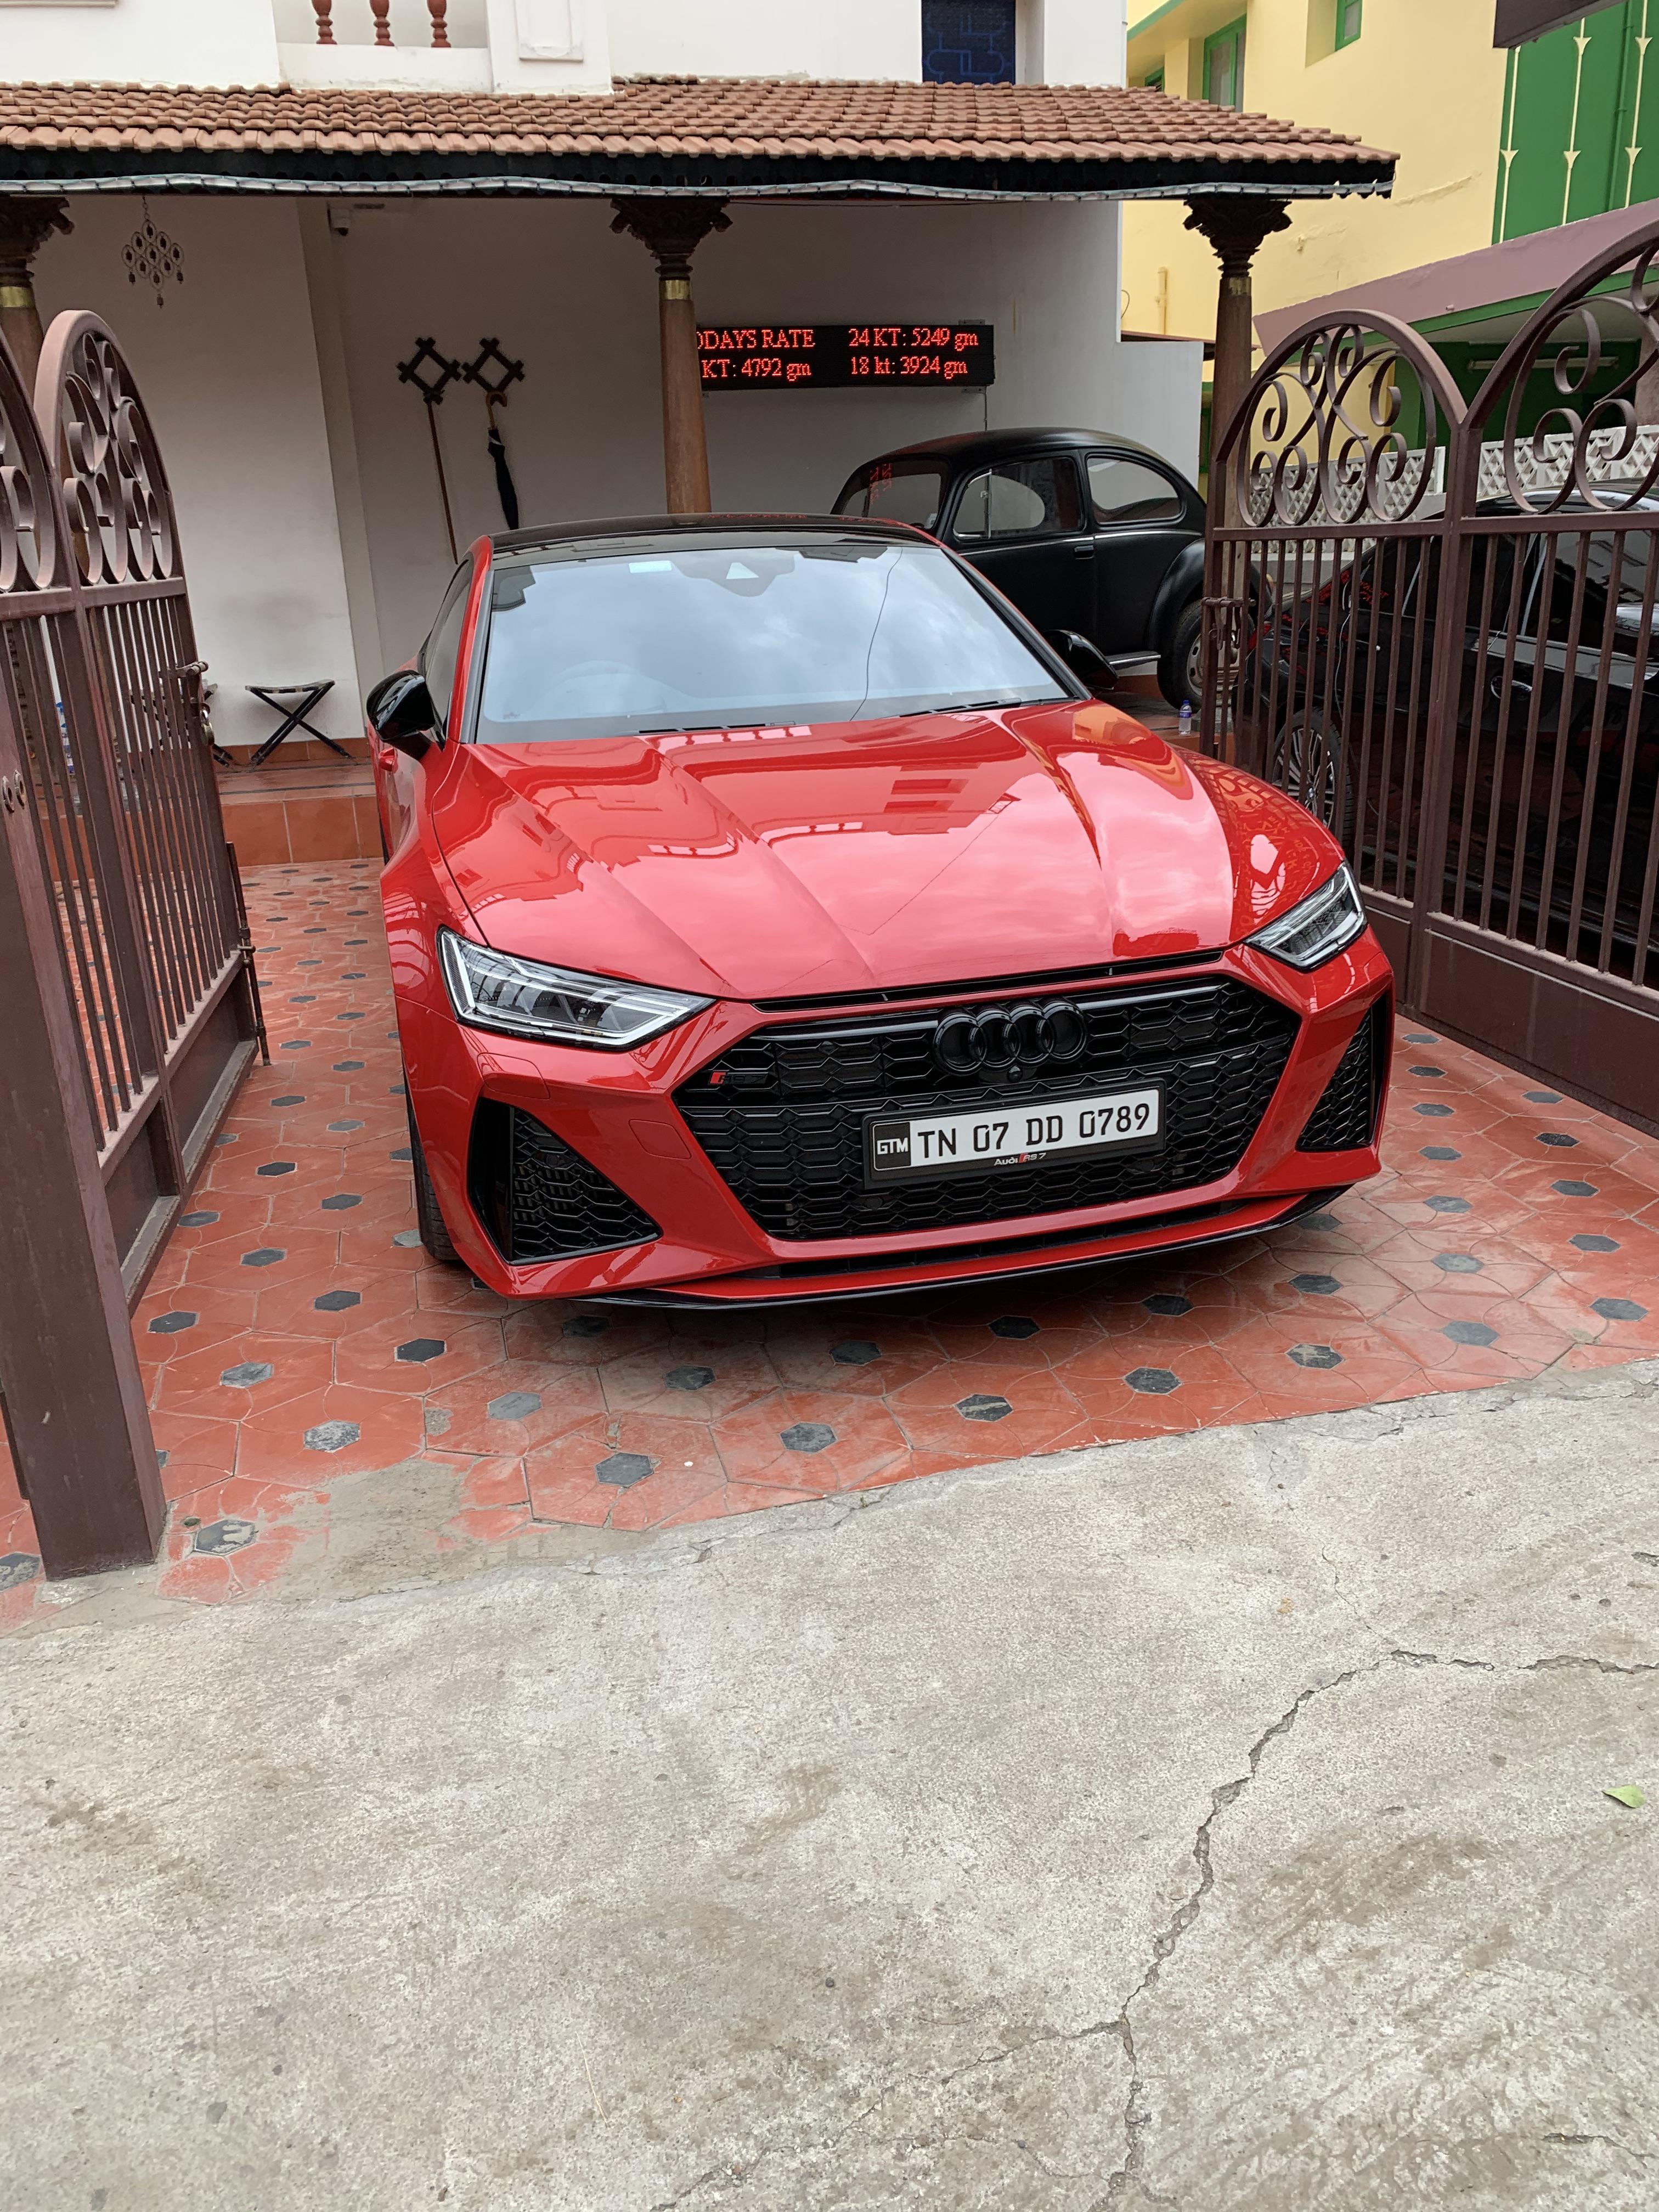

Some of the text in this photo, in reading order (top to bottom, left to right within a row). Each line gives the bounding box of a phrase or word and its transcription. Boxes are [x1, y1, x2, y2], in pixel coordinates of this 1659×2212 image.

[761, 330, 816, 348] RATE
[849, 328, 978, 351] 24 KT: 5249 gm
[702, 358, 812, 381] KT: 4792 gm
[851, 357, 869, 374] 18
[900, 356, 940, 374] 3924
[944, 362, 968, 379] gm
[917, 1103, 1150, 1158] TN 07 DD 0789
[877, 1137, 908, 1154] GTM
[994, 1156, 1018, 1166] Audi
